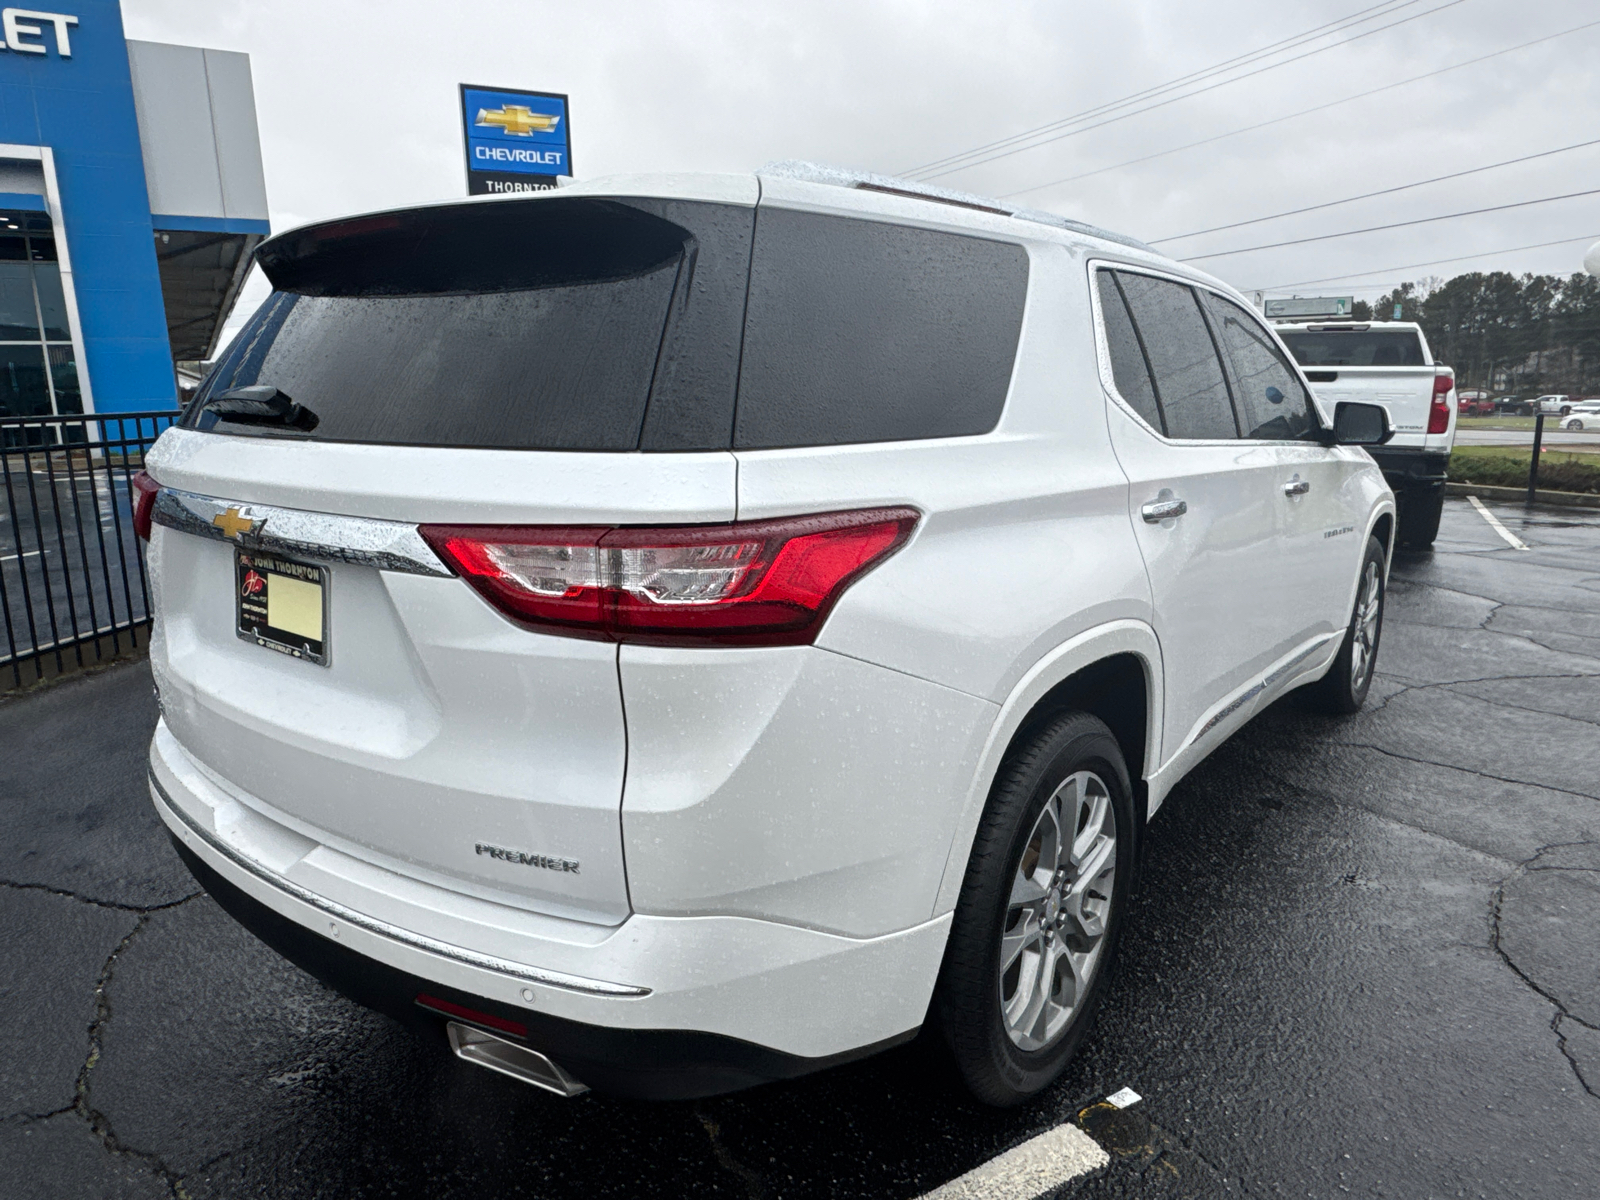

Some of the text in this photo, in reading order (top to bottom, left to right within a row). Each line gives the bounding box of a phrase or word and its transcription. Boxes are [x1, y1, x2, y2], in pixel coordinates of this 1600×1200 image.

[0, 7, 79, 56] ET
[475, 146, 562, 165] CHEVROLET
[254, 557, 320, 581] JOHN THORNTON
[475, 841, 581, 875] PREMIER
